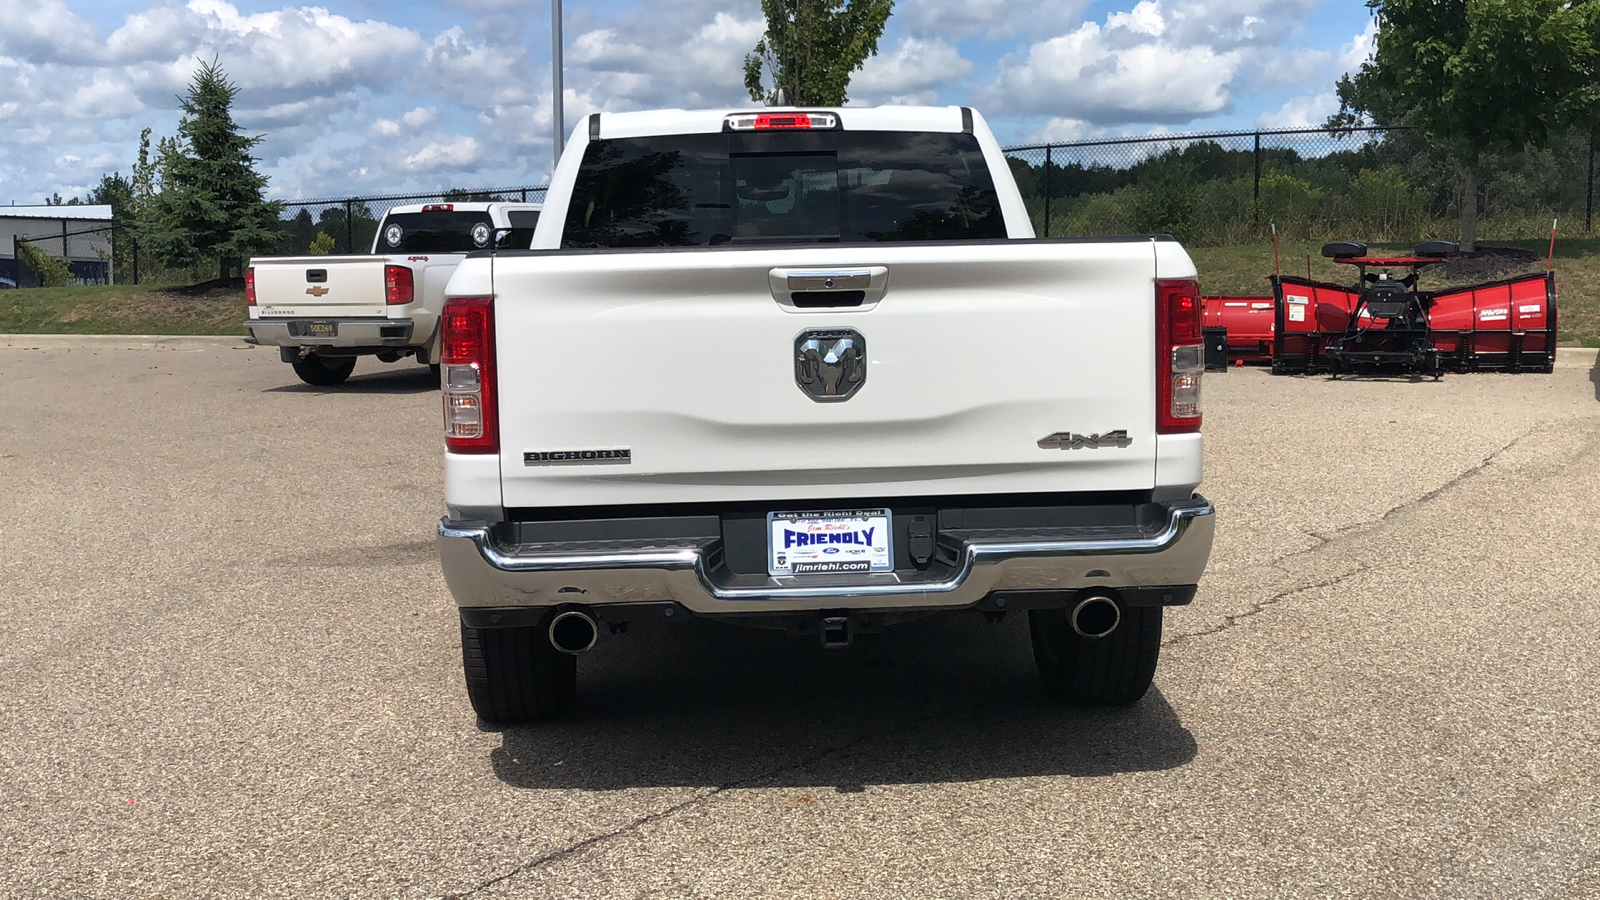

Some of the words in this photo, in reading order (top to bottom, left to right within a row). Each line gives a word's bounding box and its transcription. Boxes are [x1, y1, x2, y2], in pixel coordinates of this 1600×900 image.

[523, 449, 631, 464] BIGHORN
[807, 525, 822, 533] Jim
[784, 526, 875, 549] FRIENDLY
[795, 562, 869, 573] jimriehl.com
